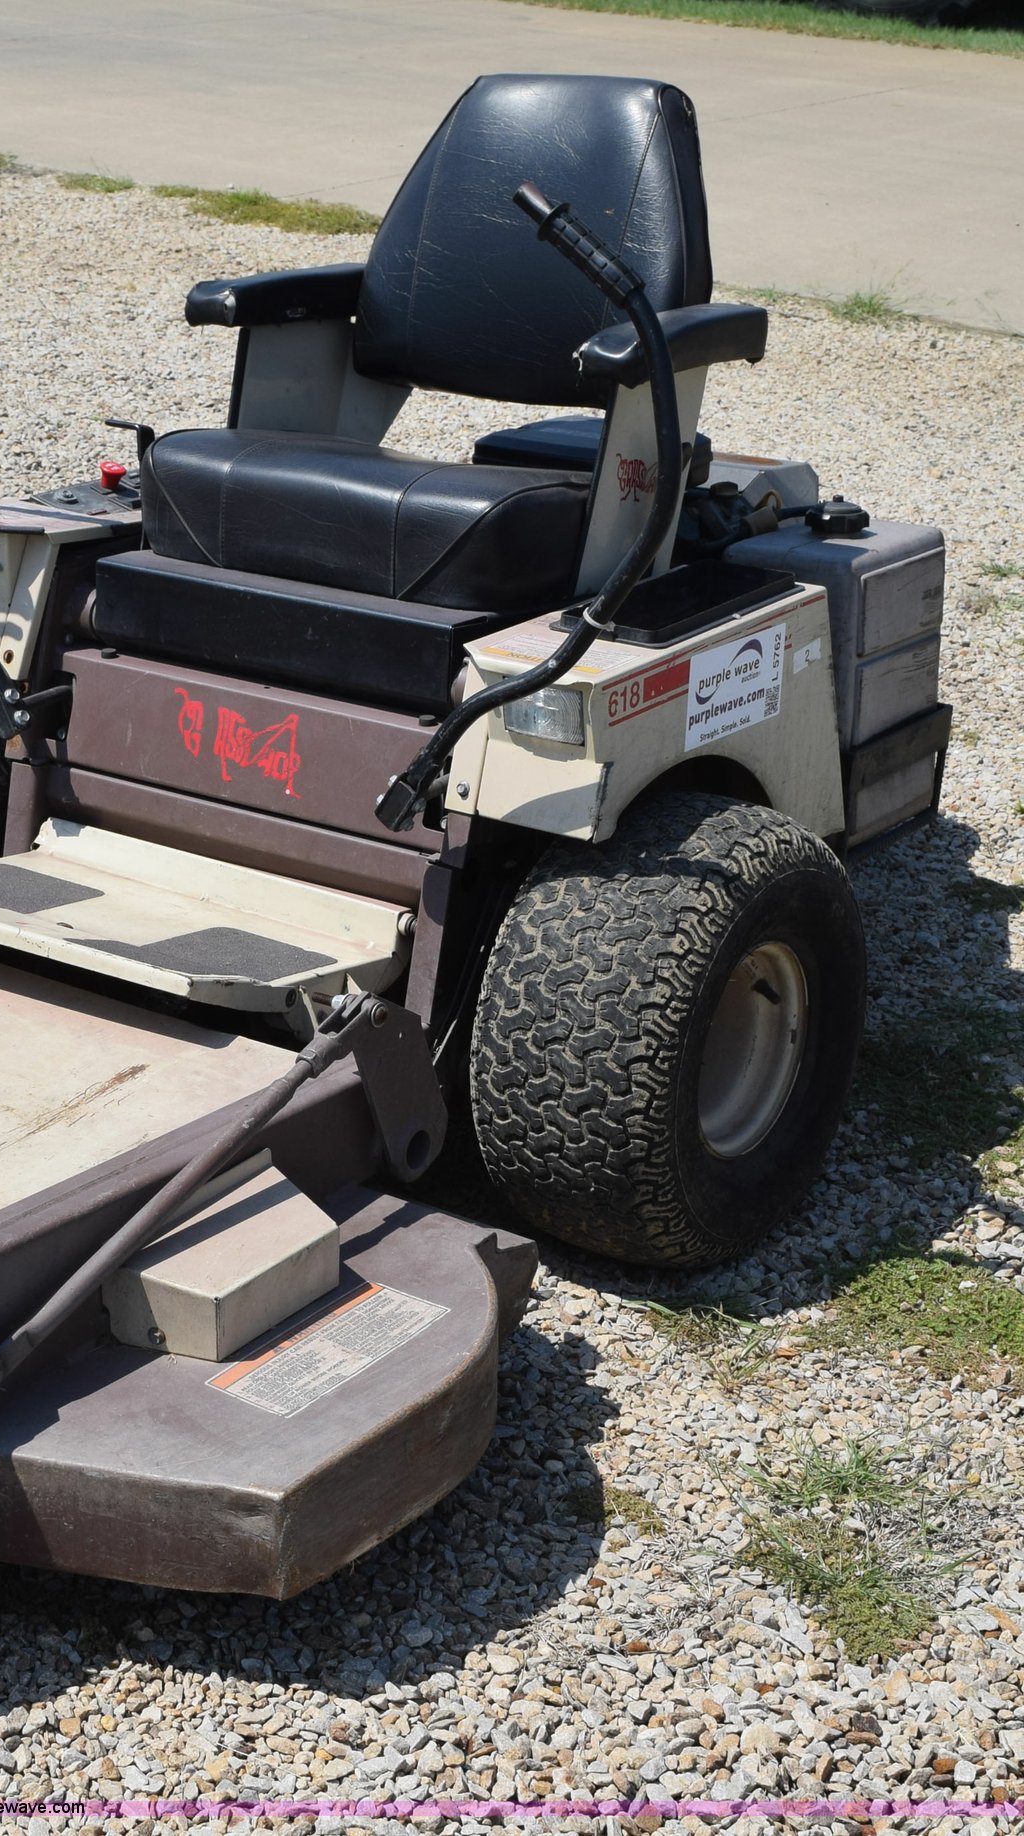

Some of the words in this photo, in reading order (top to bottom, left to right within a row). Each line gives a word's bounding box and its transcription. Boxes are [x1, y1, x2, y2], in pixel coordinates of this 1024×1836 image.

[772, 632, 782, 669] 5762
[804, 649, 810, 662] 2
[698, 668, 731, 694] purple
[734, 657, 760, 677] wave
[772, 672, 779, 682] L
[608, 681, 640, 718] 618
[688, 687, 765, 731] purplewave.com
[699, 728, 720, 742] Straight.
[721, 722, 738, 734] Simple.
[739, 714, 751, 726] Sold.
